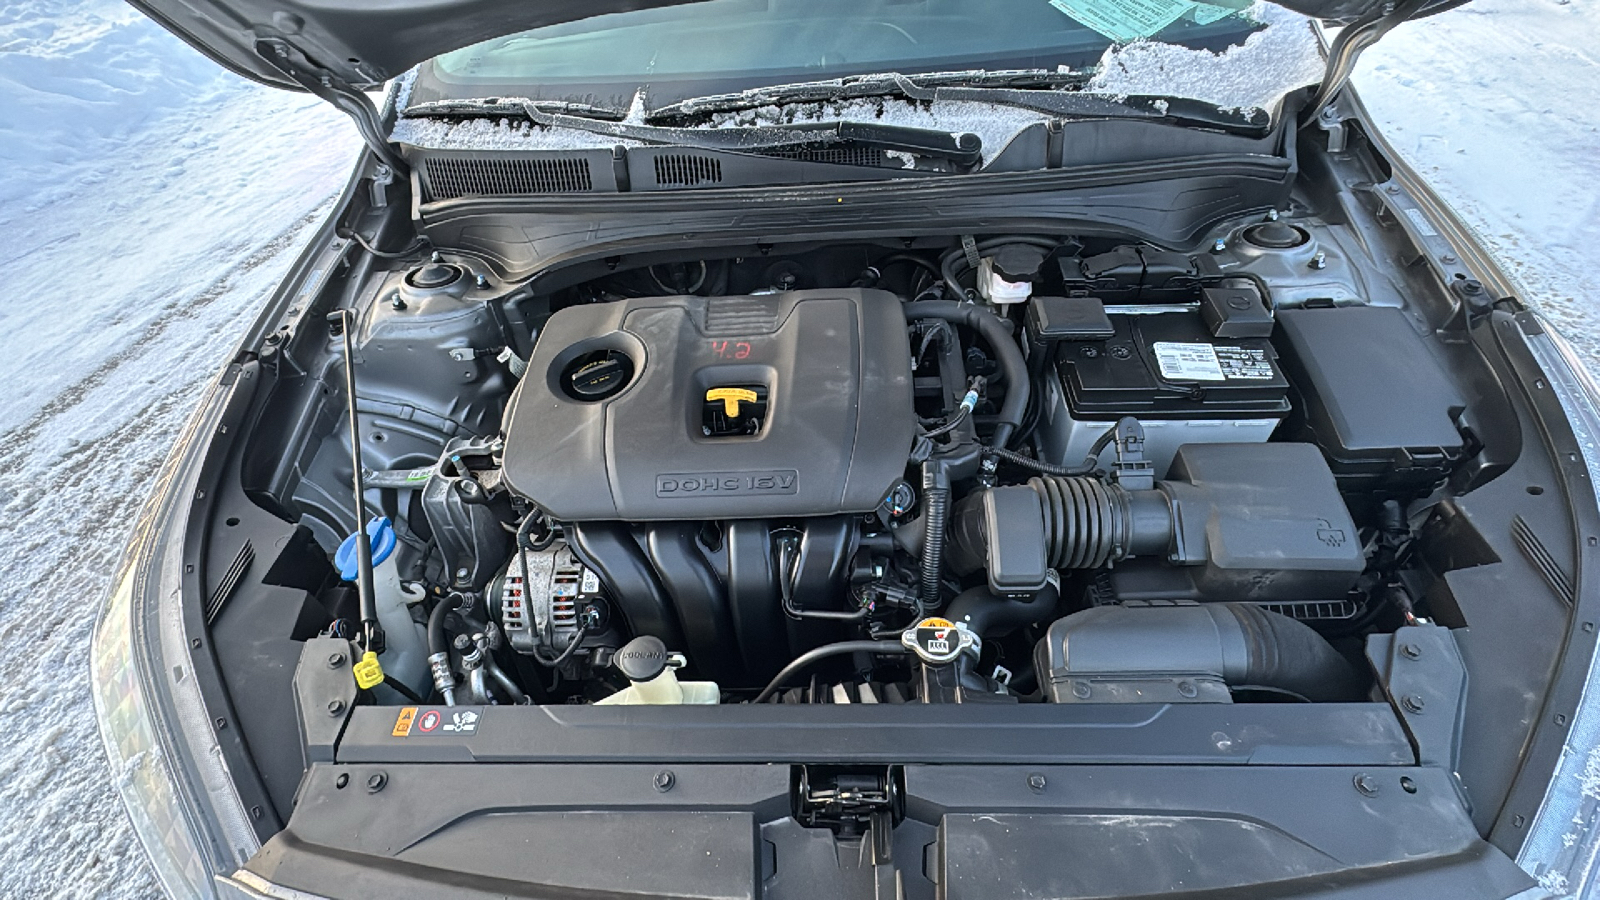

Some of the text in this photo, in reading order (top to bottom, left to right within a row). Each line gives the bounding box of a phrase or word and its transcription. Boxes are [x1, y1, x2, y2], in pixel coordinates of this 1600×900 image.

[712, 341, 751, 359] 4.2
[659, 474, 796, 493] DOHC 16V
